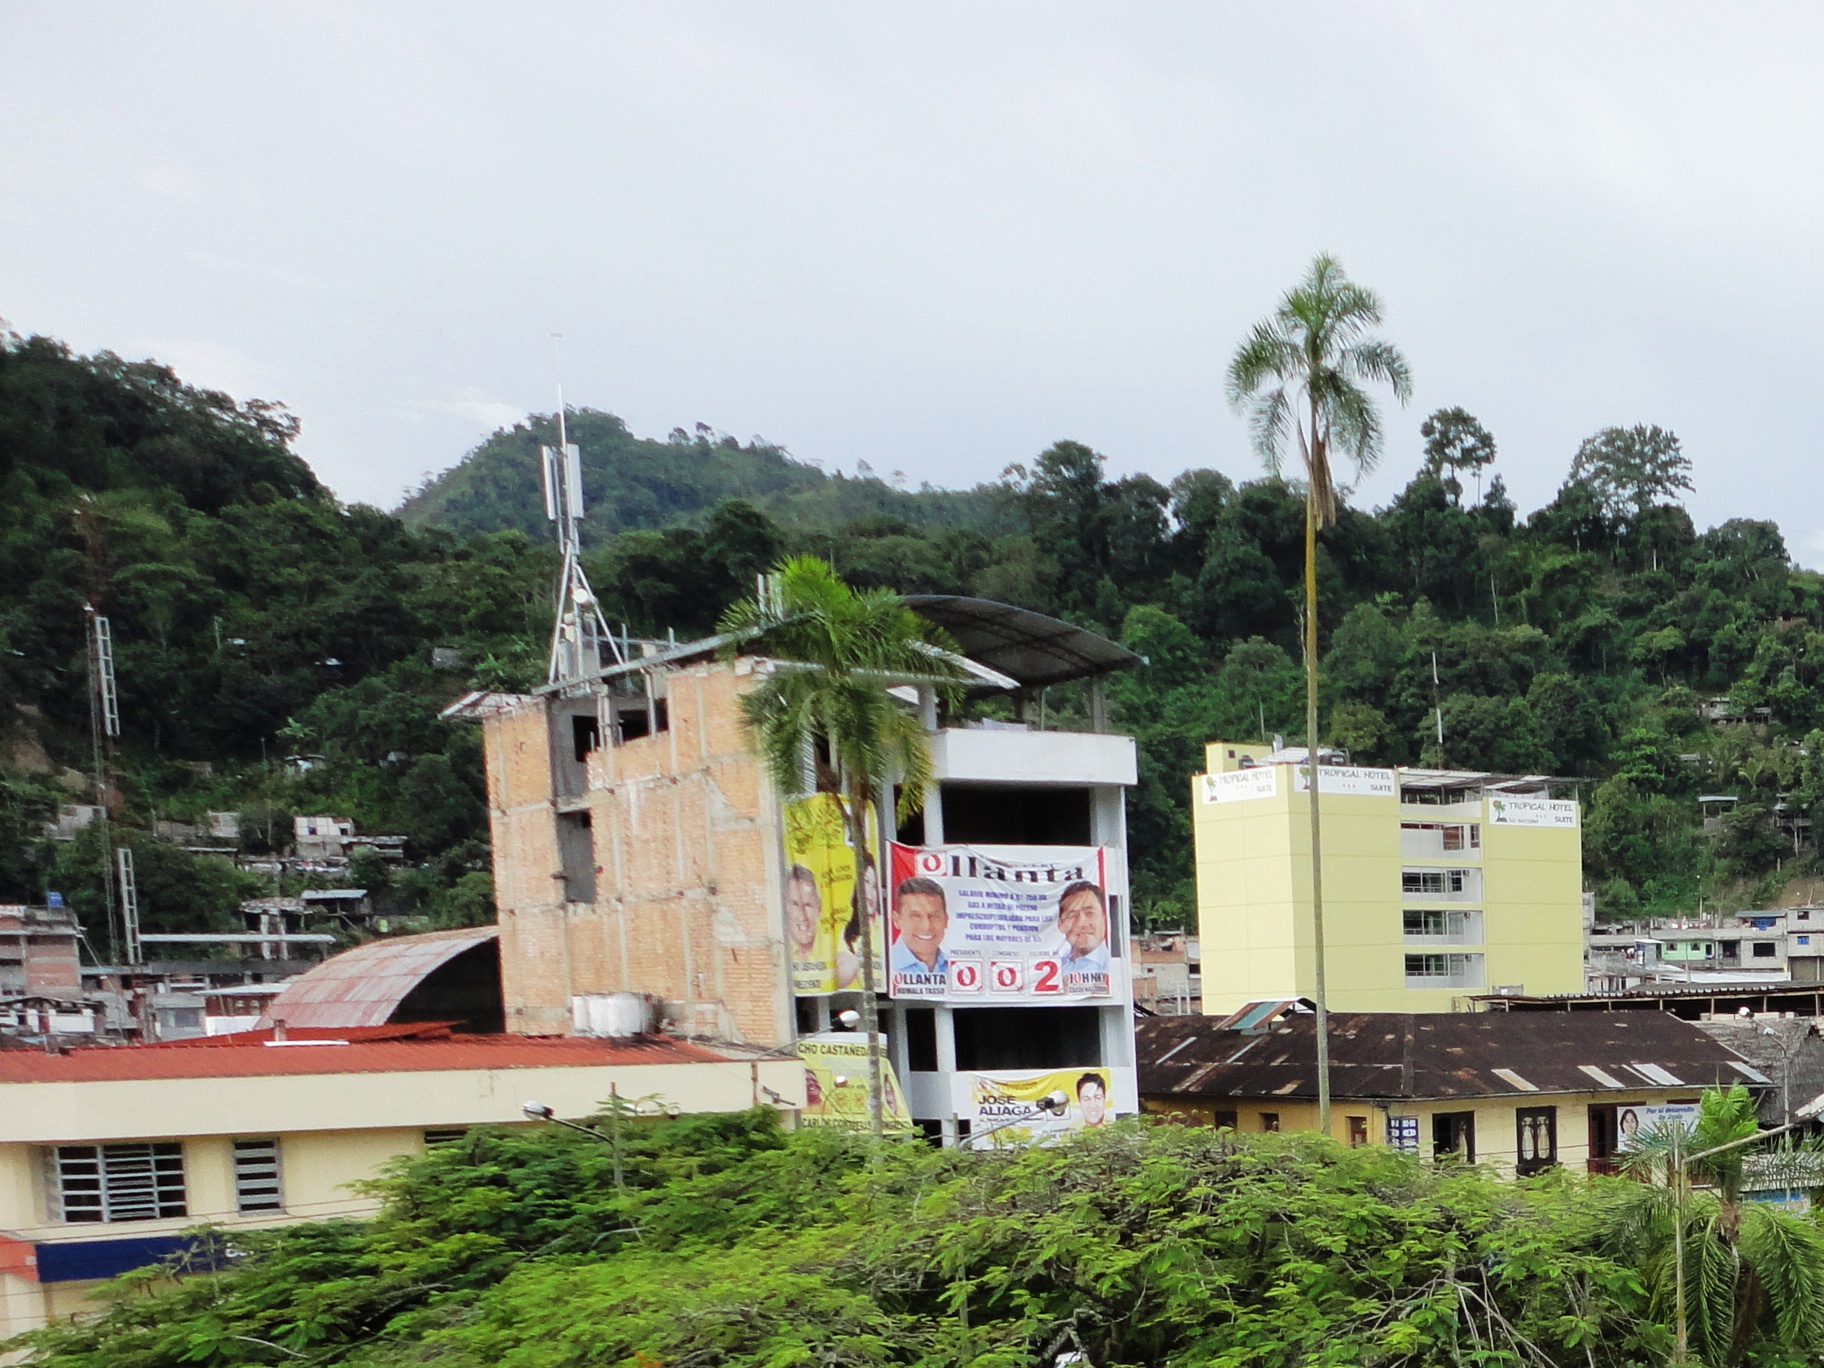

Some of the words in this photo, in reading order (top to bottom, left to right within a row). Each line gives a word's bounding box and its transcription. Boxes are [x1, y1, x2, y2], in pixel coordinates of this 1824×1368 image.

[1252, 770, 1273, 781] HOTEL
[1319, 769, 1361, 779] TROPICAL
[1364, 771, 1391, 780] HOTEL
[1370, 784, 1392, 792] SUITE
[1509, 802, 1545, 811] TROPICAL
[1549, 804, 1573, 812] HOTEL
[1554, 816, 1573, 824] SUITE
[893, 971, 947, 986] OLLANTA
[1033, 960, 1060, 992] 2
[978, 1095, 1017, 1106] JOSE
[978, 1106, 1033, 1116] ALIAGA
